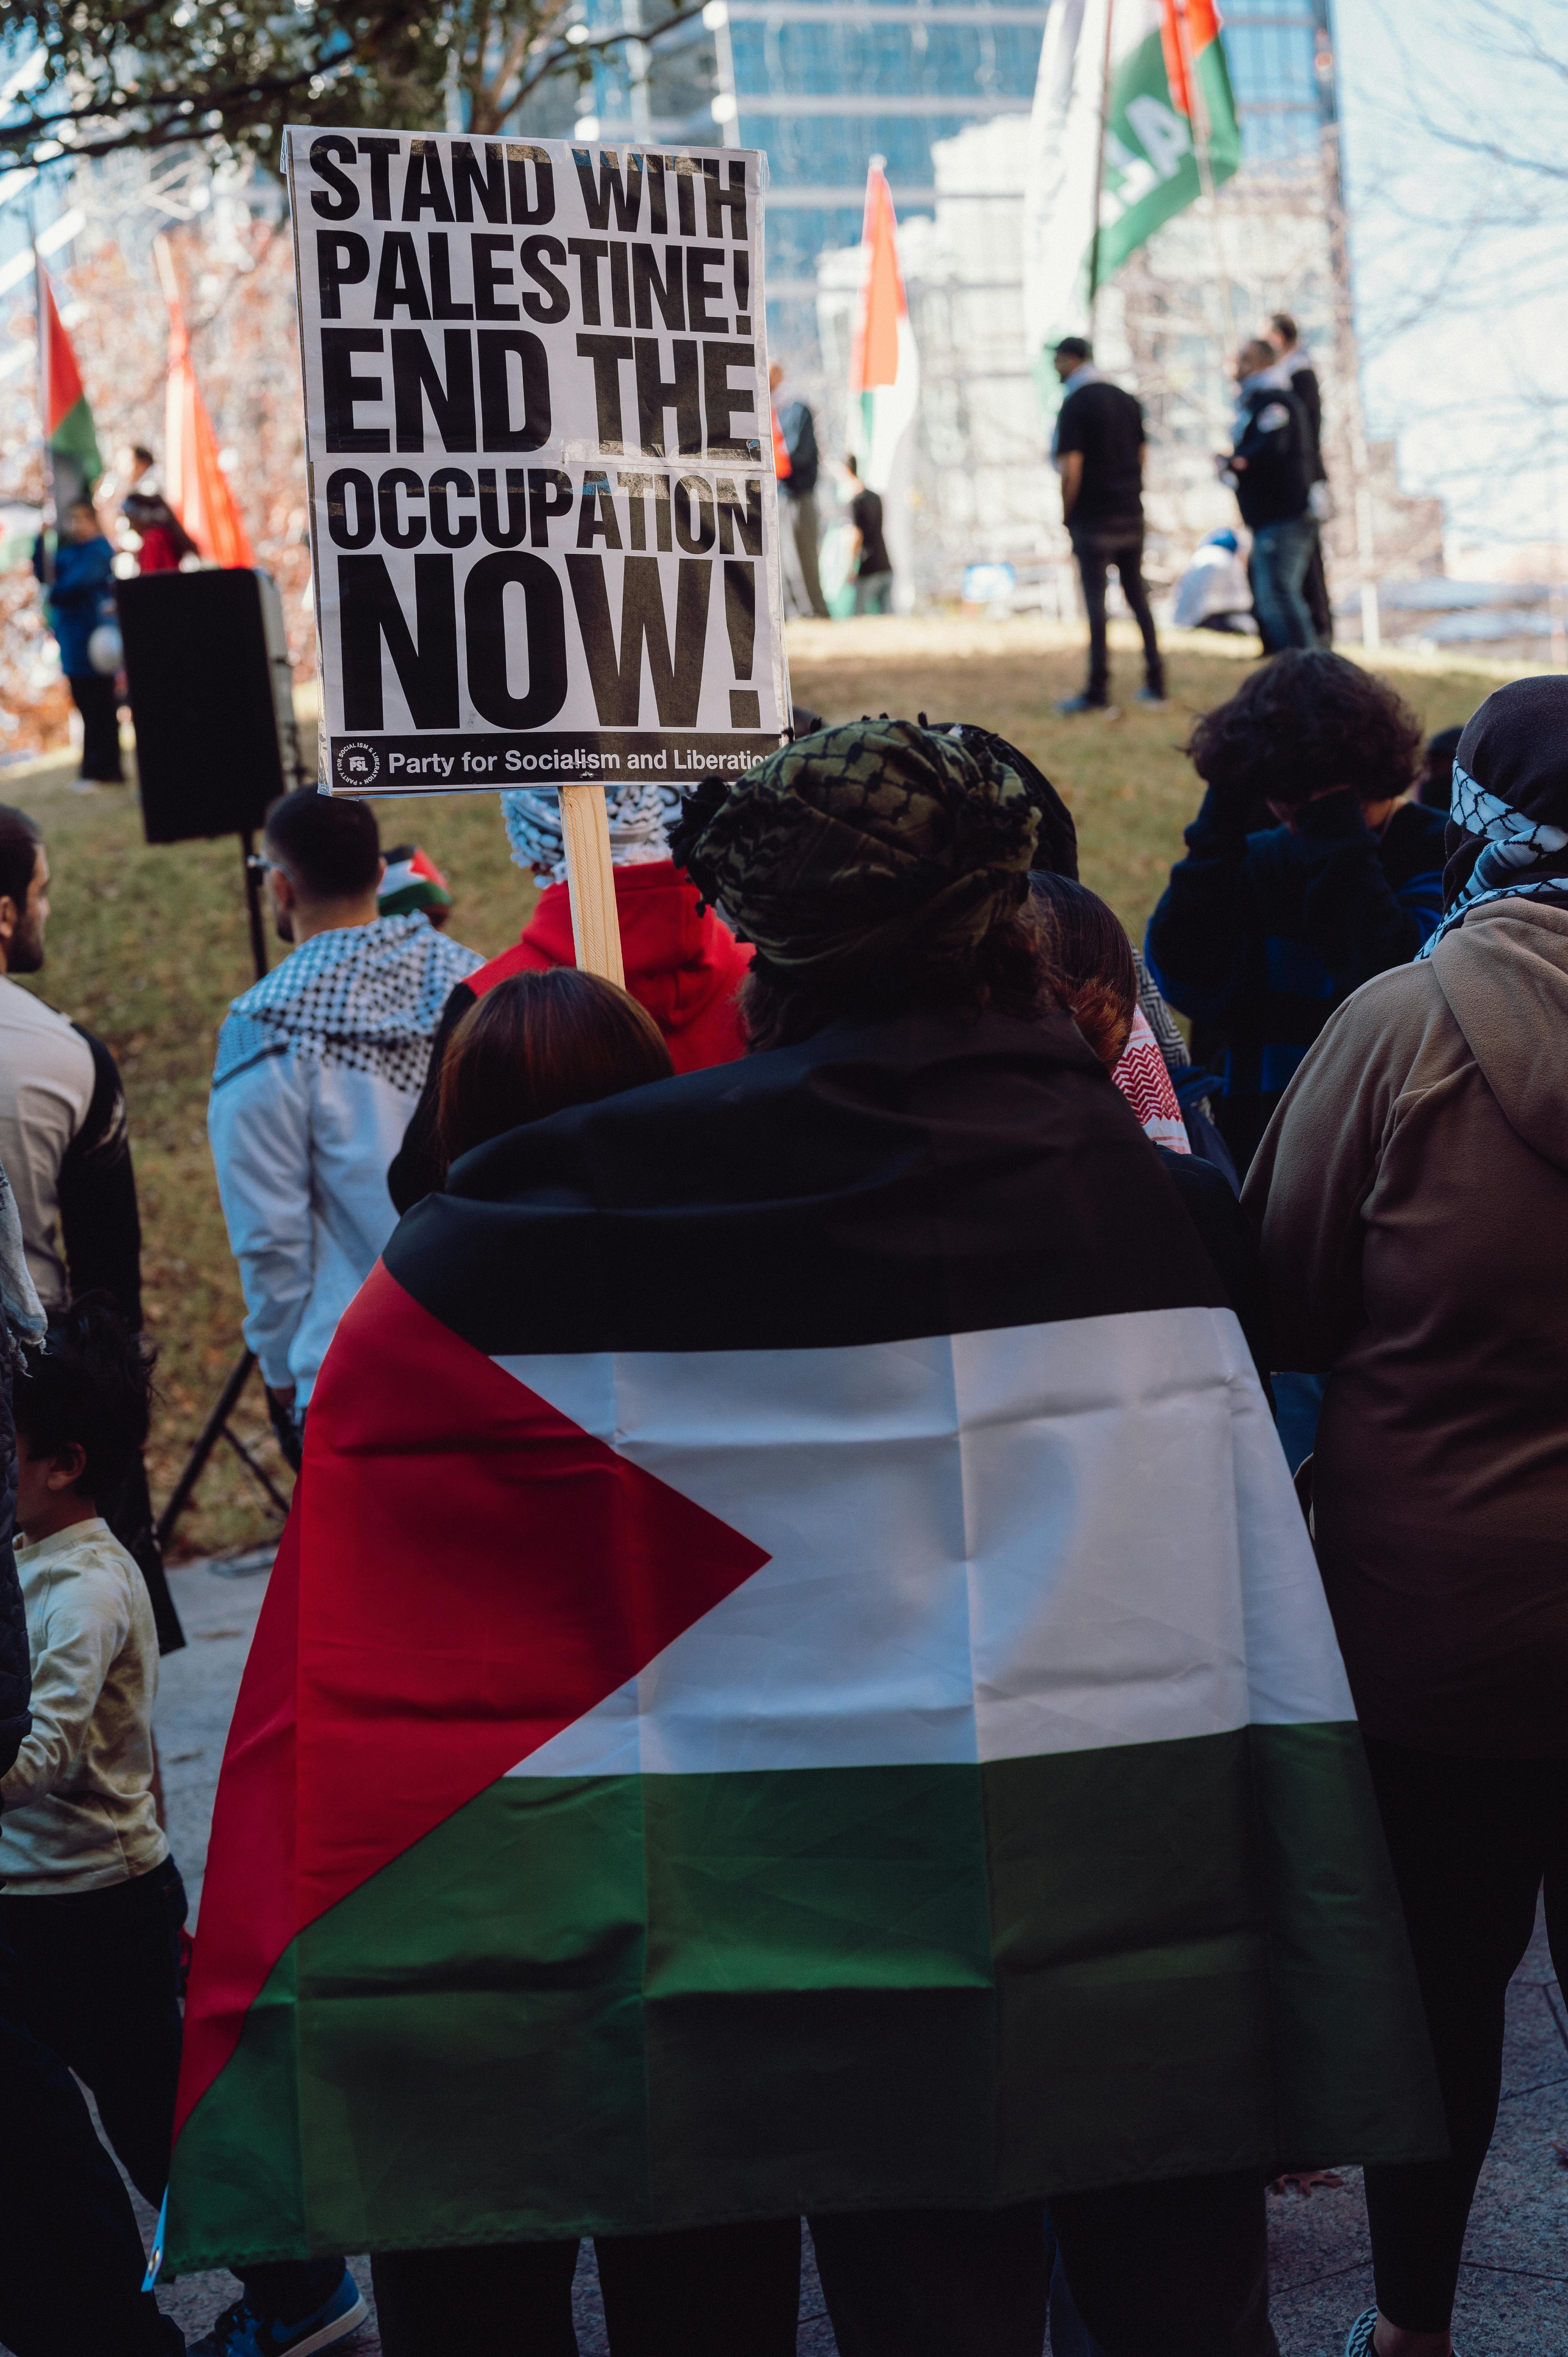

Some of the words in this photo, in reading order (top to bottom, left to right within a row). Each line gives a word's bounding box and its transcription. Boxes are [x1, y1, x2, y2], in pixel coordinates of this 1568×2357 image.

[310, 134, 556, 226] STAND
[571, 148, 748, 241] WITH
[317, 230, 751, 336] PALESTINE!
[321, 327, 552, 453] END
[576, 333, 761, 462] THE
[326, 467, 763, 557] OCCUPATION
[337, 550, 761, 731] NOW!
[339, 742, 368, 757] SOCIALISM
[339, 772, 357, 785] PARTY
[350, 760, 368, 771] PSL
[364, 752, 380, 784] LIBERATION
[389, 753, 455, 777] Party
[462, 751, 498, 772] for
[505, 749, 620, 771] Socialism
[627, 749, 667, 770] and
[674, 749, 772, 770] Liberatio
